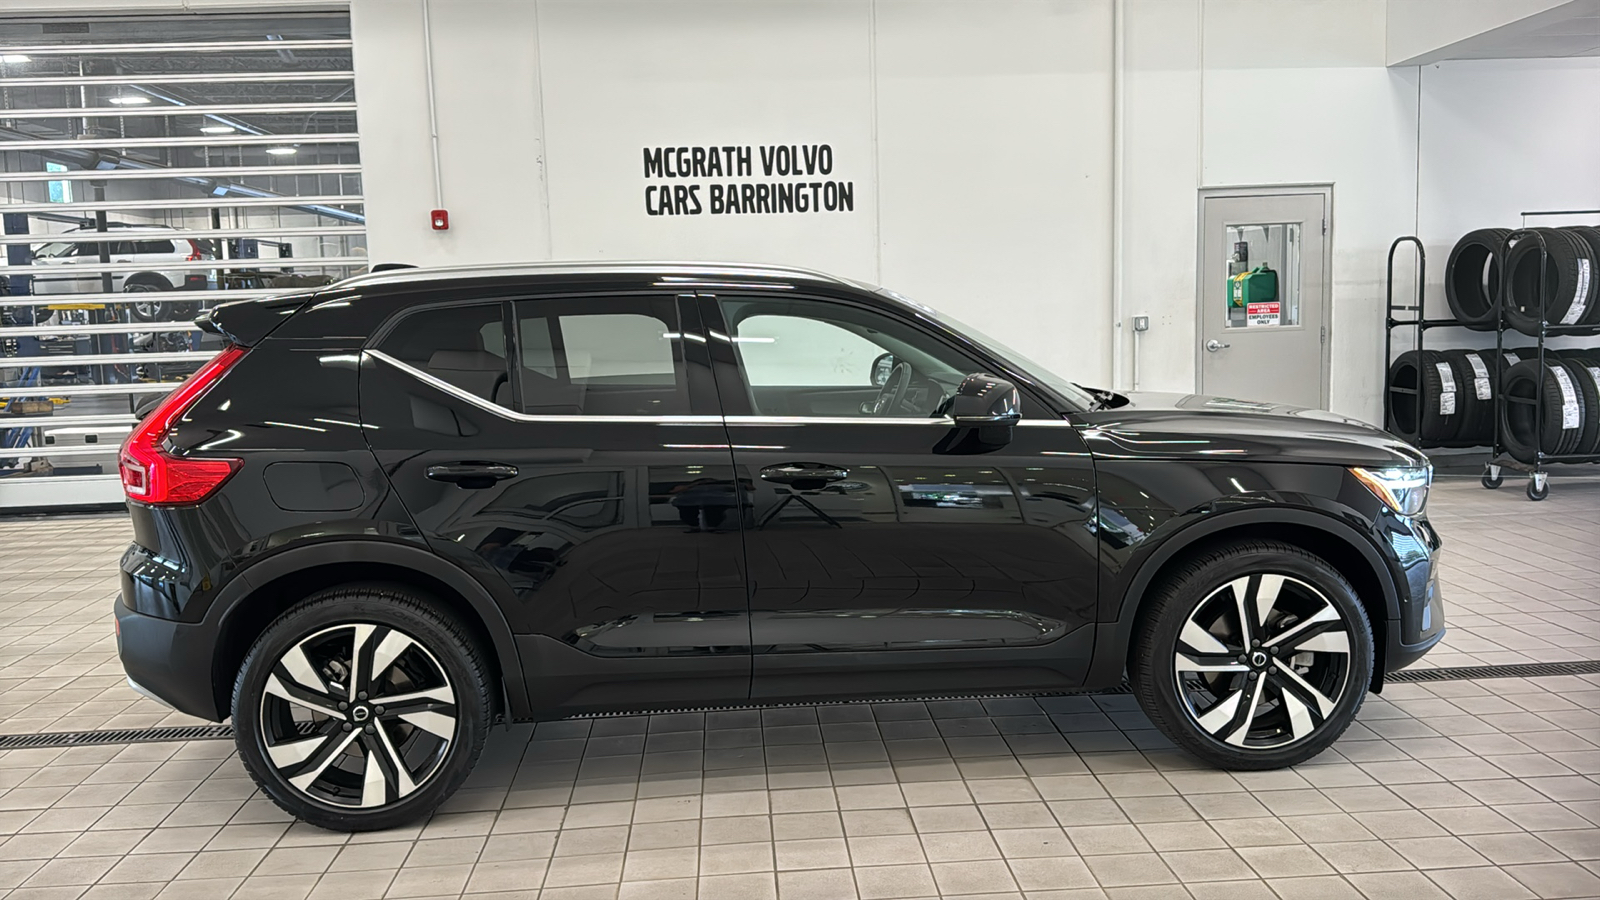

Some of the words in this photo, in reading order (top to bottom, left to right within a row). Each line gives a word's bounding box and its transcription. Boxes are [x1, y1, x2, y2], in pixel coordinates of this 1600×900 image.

[643, 146, 752, 178] MCGRATH
[759, 144, 833, 176] VOLVO
[645, 184, 702, 215] CARS
[710, 181, 854, 214] BARRINGTON
